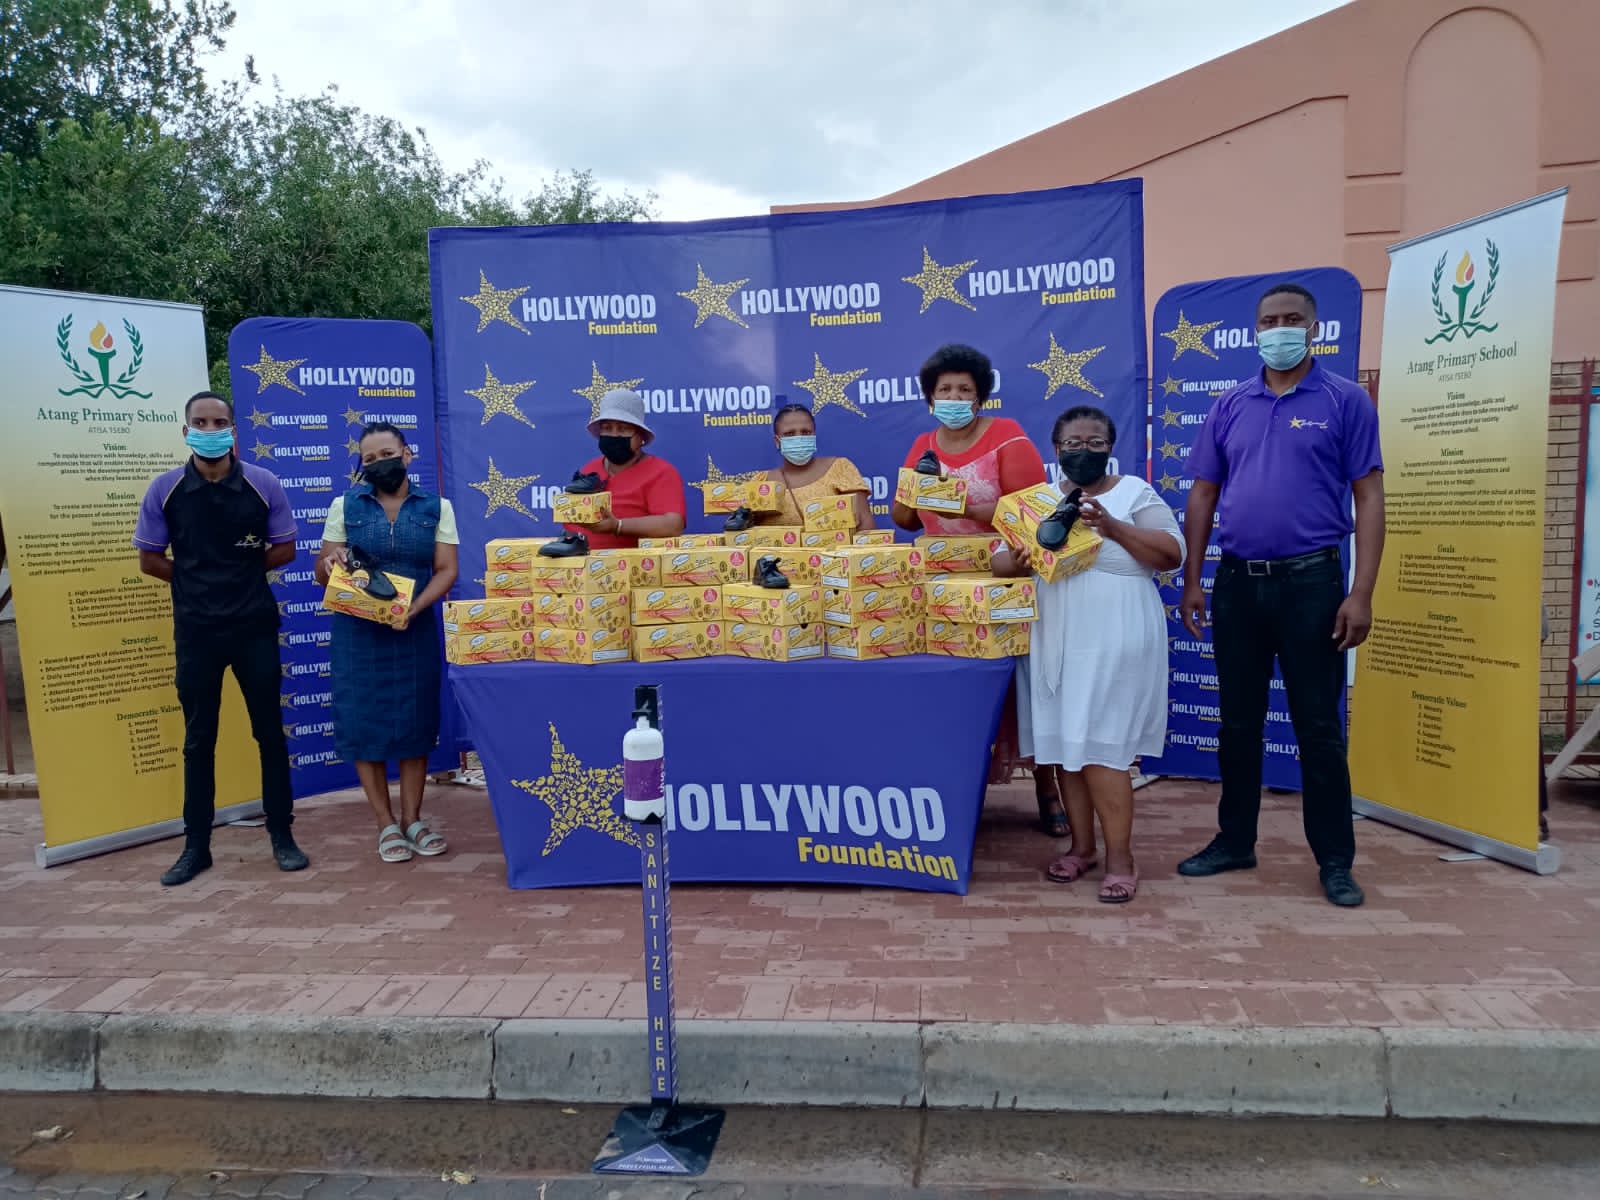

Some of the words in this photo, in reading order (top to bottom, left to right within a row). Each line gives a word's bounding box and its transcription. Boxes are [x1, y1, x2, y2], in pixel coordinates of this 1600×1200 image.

[969, 257, 1115, 298] HOLLYWOOD
[741, 282, 880, 315] HOLLYWOOD
[1041, 287, 1116, 305] Foundation
[522, 294, 656, 322] HOLLYWOOD
[810, 311, 881, 327] Foundation
[588, 321, 657, 335] Foundation
[1310, 343, 1339, 355] ation
[1406, 361, 1434, 375] Atang
[1437, 352, 1477, 370] Primary
[1479, 341, 1517, 361] School
[300, 367, 416, 386] HOLLYWOOD
[358, 386, 416, 398] Foundation
[1182, 380, 1238, 392] HOLLYWOOD
[37, 408, 78, 424] Atang
[82, 408, 134, 425] Primary
[138, 410, 177, 423] School
[272, 415, 328, 425] HOLLYWOOD
[365, 414, 417, 424] HOLLYWOOD
[703, 412, 772, 427] Foundation
[1181, 414, 1208, 425] HOLLY
[274, 445, 330, 457] HOLLYWOOD
[1440, 448, 1464, 457] Mission
[106, 492, 136, 500] Mission
[292, 508, 327, 518] LLYWOO
[121, 576, 143, 585] Goals
[284, 570, 316, 582] HOLLY
[287, 602, 323, 613] HOLLYW
[121, 635, 158, 646] Strategies
[289, 632, 331, 645] HOLLYWO
[1174, 641, 1214, 653] HOLLYW
[292, 662, 331, 675] HOLLYW
[1173, 672, 1219, 685] HOLLYWO
[294, 692, 332, 706] HOLLYW
[117, 710, 159, 721] Democratic
[160, 704, 182, 713] Values
[1172, 703, 1220, 716] HOLLYWOO
[295, 722, 334, 736] HOLLYW
[1170, 734, 1220, 747] HOLLYWOO
[1266, 743, 1300, 755] HOLLY
[298, 751, 337, 765] HOLLYW
[798, 837, 959, 881] Foundation
[645, 832, 662, 991] SANITIZE
[653, 1016, 666, 1091] HERE
